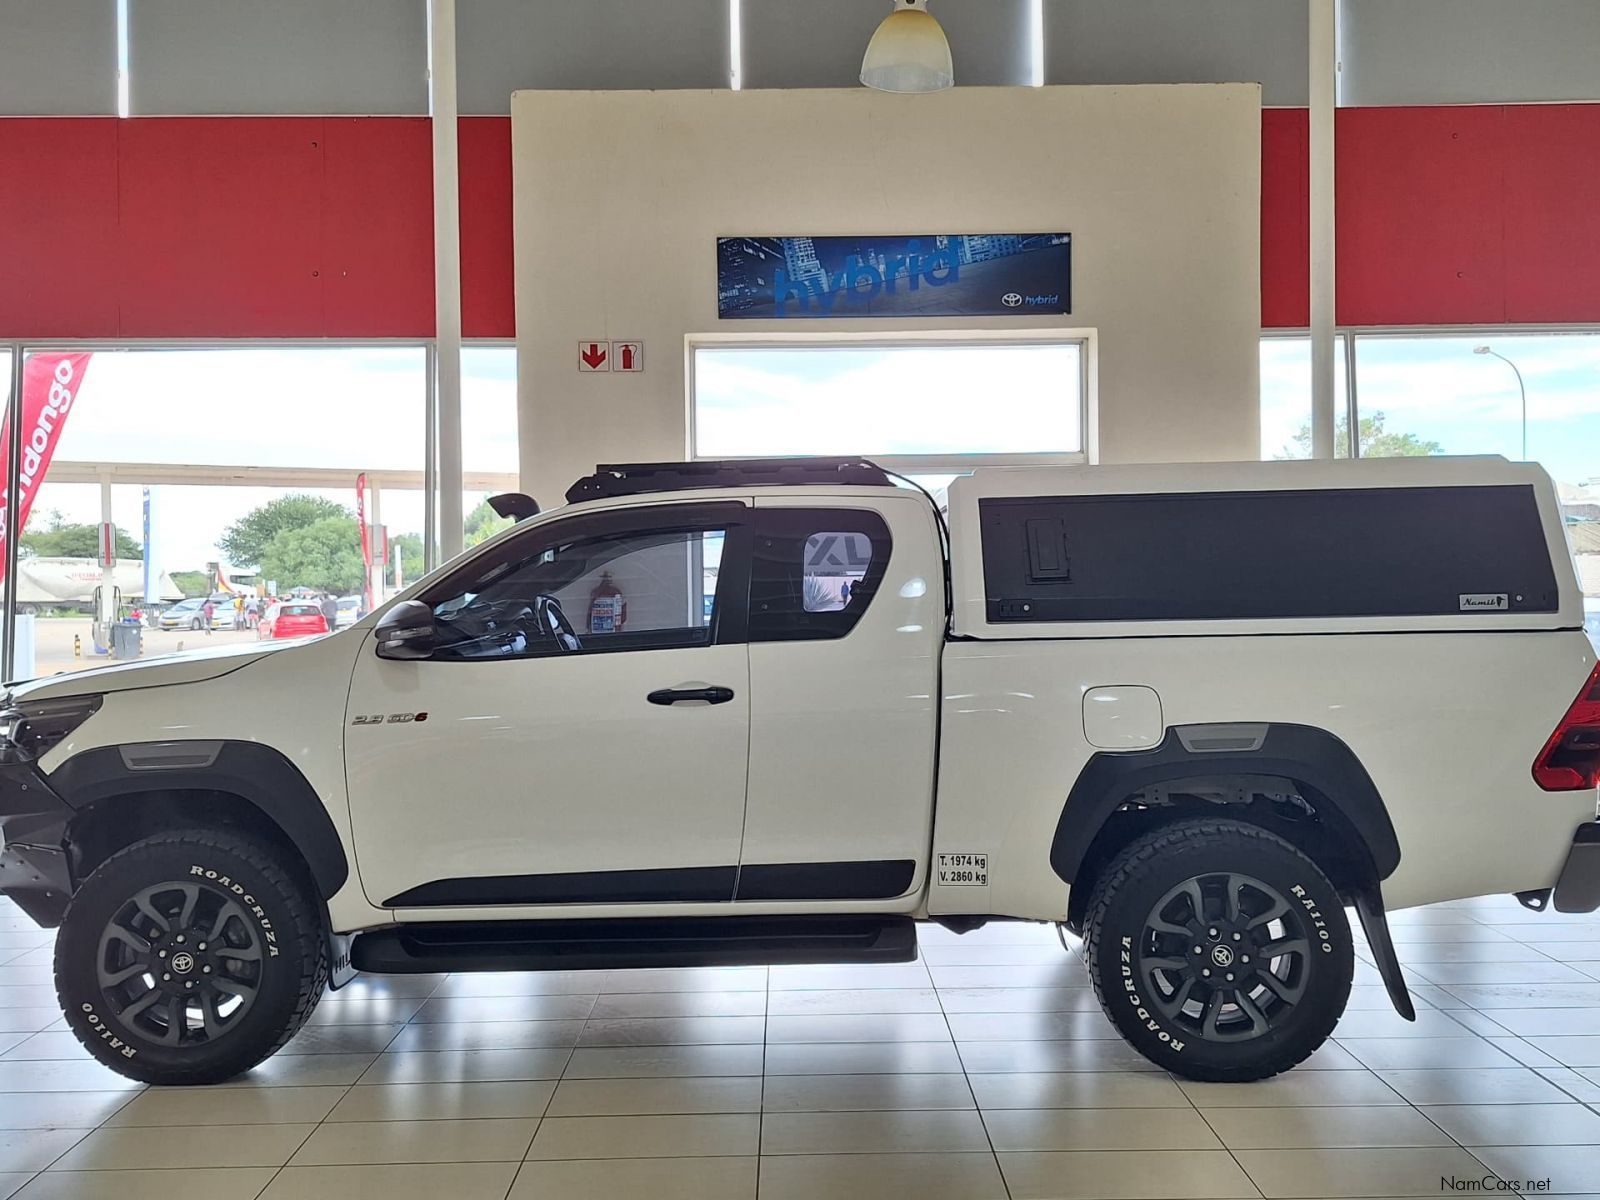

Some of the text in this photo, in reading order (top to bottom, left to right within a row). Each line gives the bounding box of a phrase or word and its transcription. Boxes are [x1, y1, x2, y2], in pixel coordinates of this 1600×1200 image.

[774, 236, 961, 317] hybrid
[1025, 294, 1059, 307] hybrid
[1463, 597, 1496, 606] Namib
[939, 855, 986, 869] T. 1974 kg
[940, 871, 986, 885] V. 2860 kg
[190, 864, 280, 957] ROADCRUZA
[1290, 884, 1332, 953] RA1100
[1121, 936, 1186, 1053] ROADCRUZA
[82, 1002, 137, 1059] RA1100
